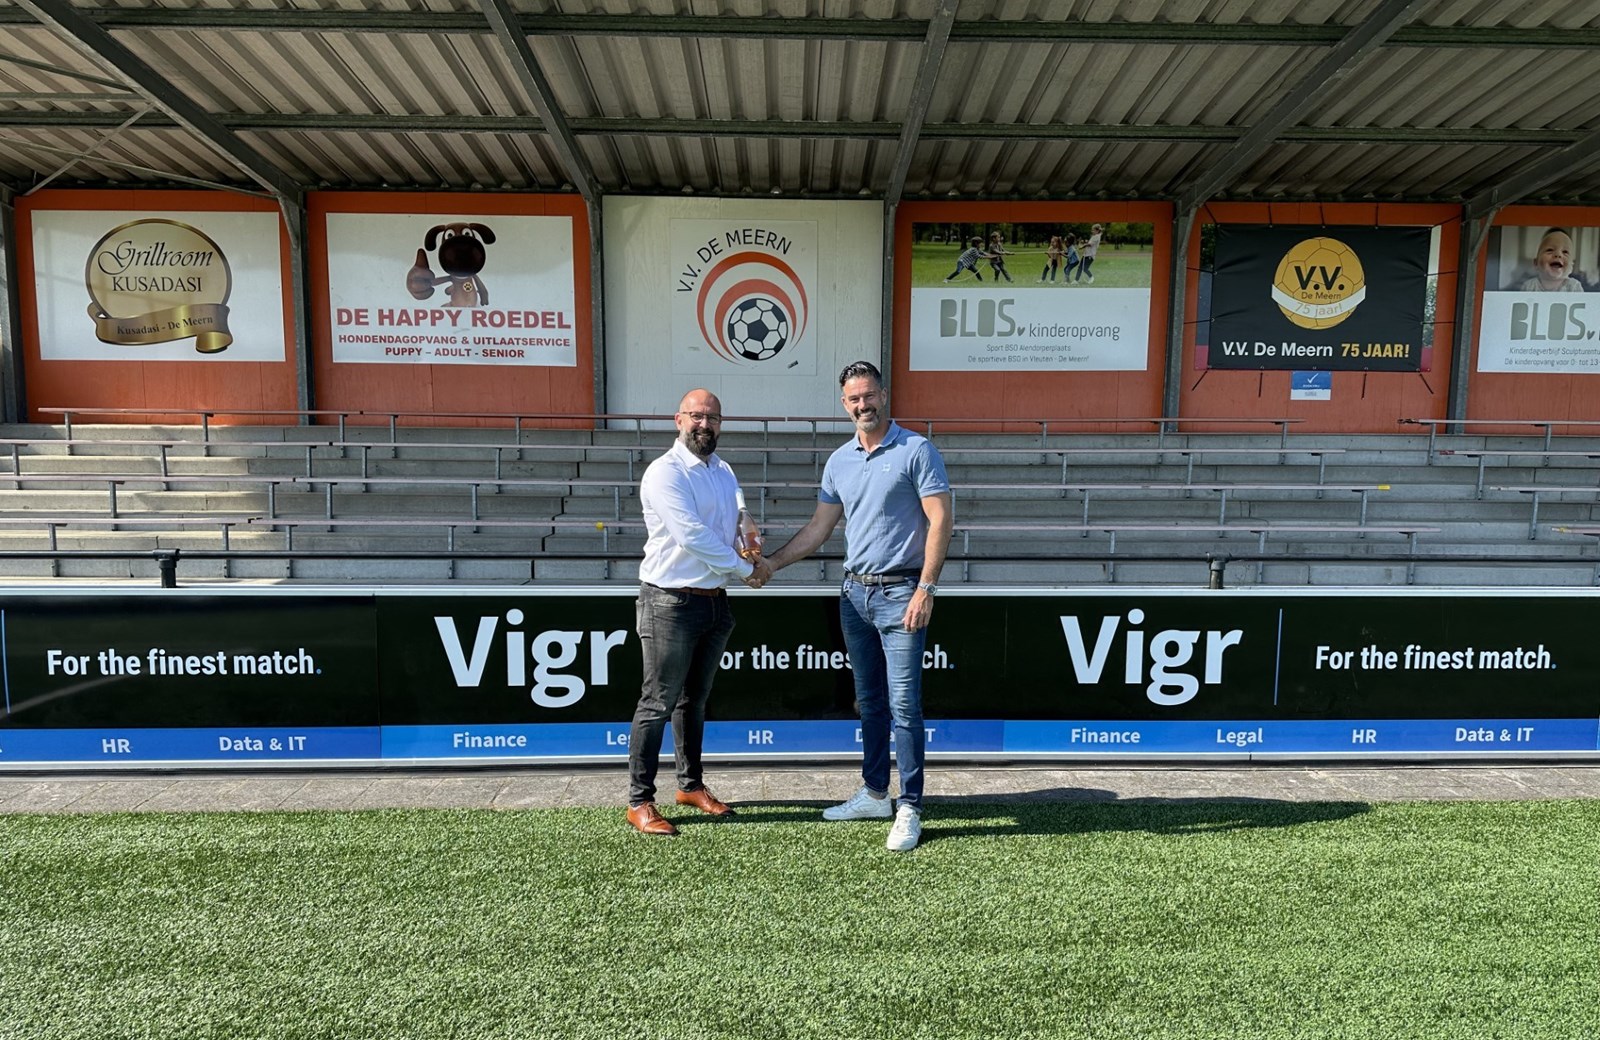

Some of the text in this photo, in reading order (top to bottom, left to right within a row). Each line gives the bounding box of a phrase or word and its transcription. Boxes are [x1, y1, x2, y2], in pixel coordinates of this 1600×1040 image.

[98, 240, 213, 275] Grillroom
[677, 228, 792, 293] V.V. DE MEERN
[112, 276, 202, 292] KUSADASI
[1294, 266, 1345, 291] V.V.
[1301, 292, 1341, 300] De Meern
[940, 298, 1016, 337] BLOS
[1295, 302, 1343, 317] 75 jaar!
[117, 323, 160, 335] Kusadasi
[168, 318, 181, 330] De
[182, 315, 213, 328] Meern
[336, 308, 572, 329] DE HAPPY ROEDEL
[1510, 302, 1586, 340] BLOS
[338, 334, 571, 347] HONDENDAGOPVANG & UITLAATSERVICE
[1029, 323, 1121, 341] kinderopvang
[385, 347, 422, 357] PUPPY
[434, 348, 472, 357] ADULT
[482, 348, 525, 358] SENIOR
[986, 344, 1004, 353] Sport
[1005, 344, 1018, 352] BSO
[1222, 341, 1410, 357] V.V. De Meern 75 JAAR!
[47, 648, 322, 675] For the finest match.
[434, 608, 628, 708] Vigr
[719, 651, 744, 669] or
[751, 644, 790, 669] the
[795, 644, 852, 669] fine
[1060, 608, 1244, 706] Vigr
[1316, 644, 1557, 669] For the finest match.
[453, 732, 527, 748] Finance
[748, 730, 774, 745] HR
[1071, 727, 1141, 743] Finance
[1216, 727, 1263, 747] Legal
[1352, 729, 1377, 743] HR
[1455, 727, 1534, 742] Data & IT
[102, 738, 131, 753] HR
[219, 736, 306, 751] Data & IT
